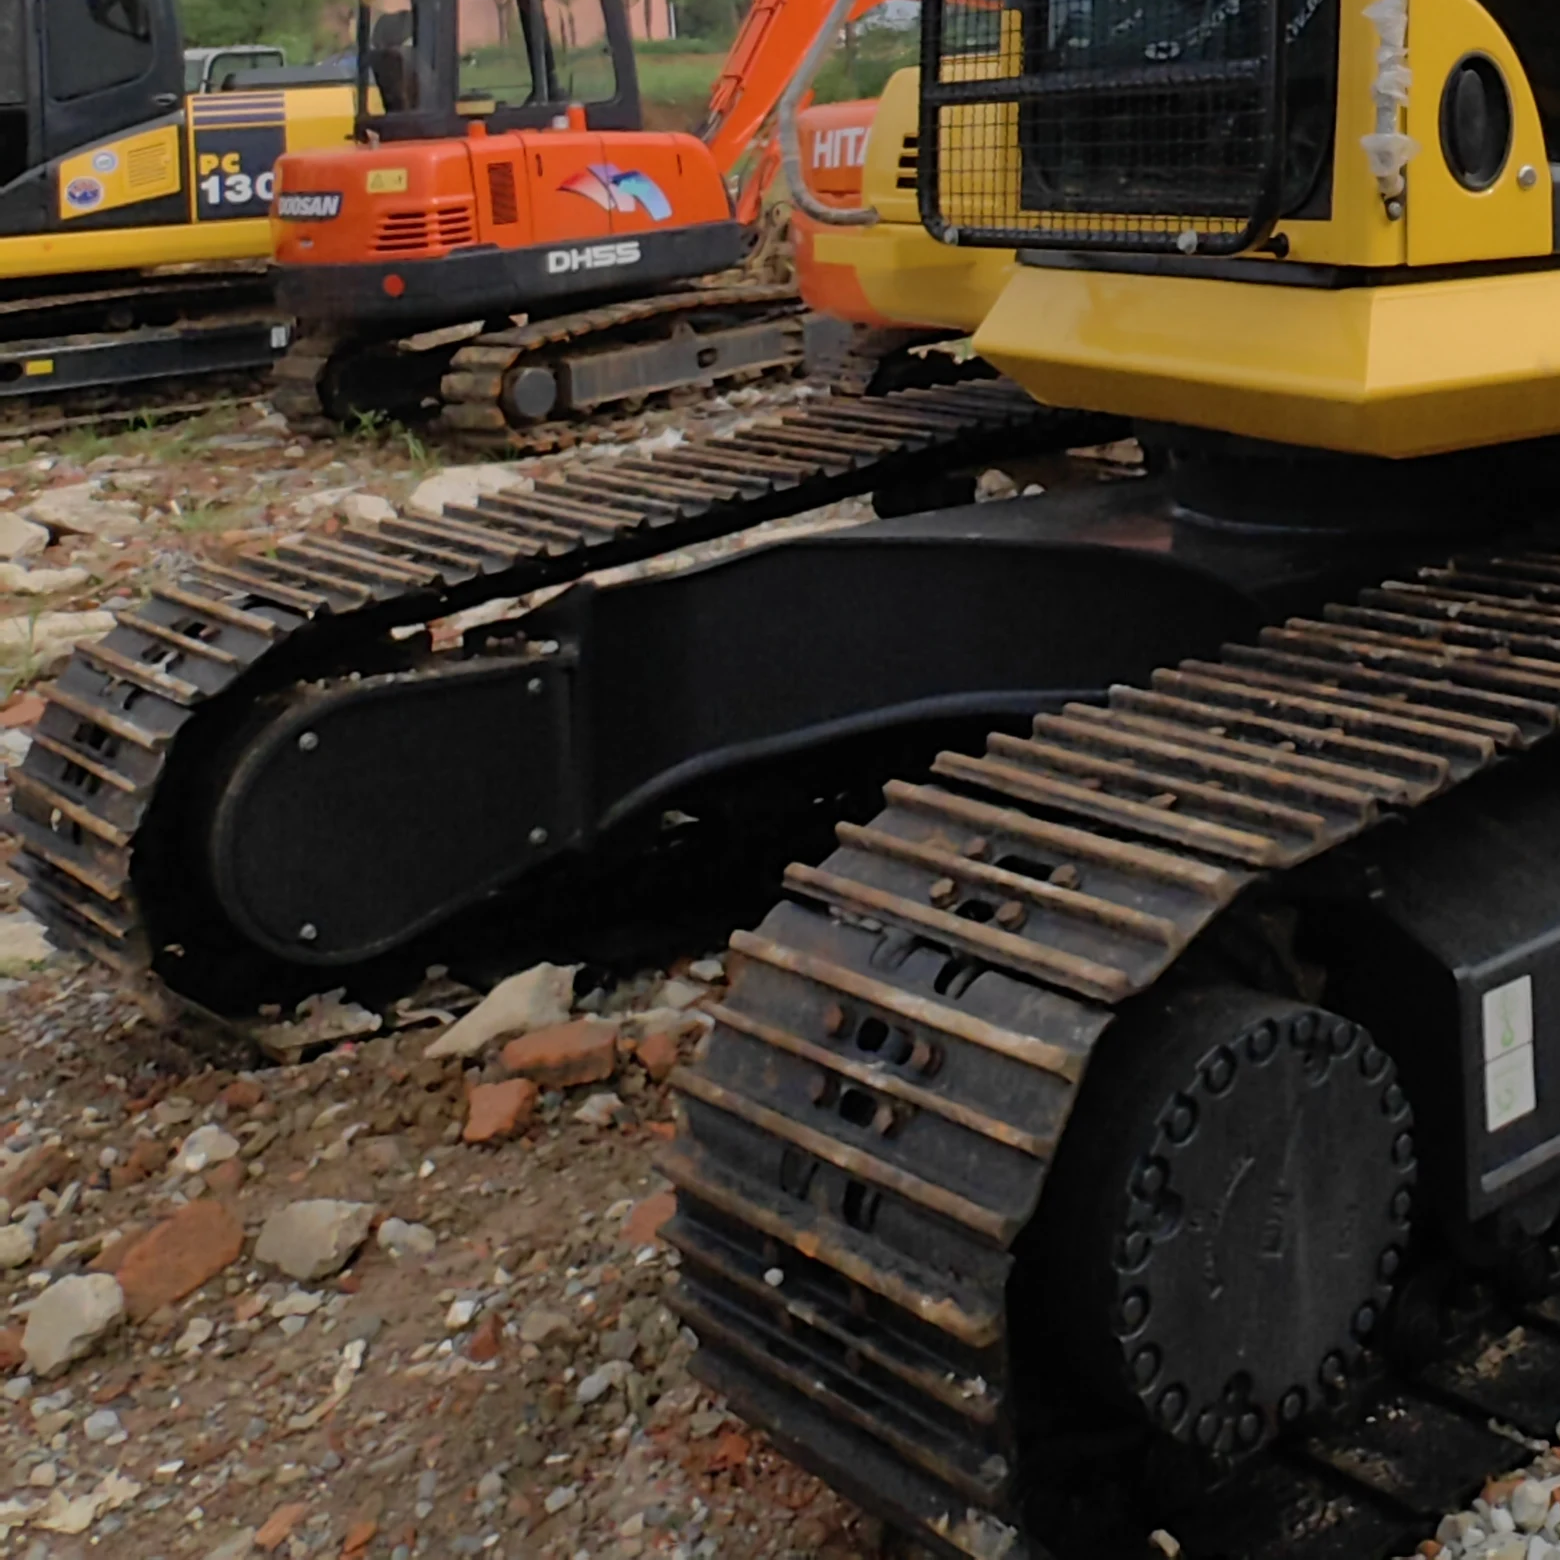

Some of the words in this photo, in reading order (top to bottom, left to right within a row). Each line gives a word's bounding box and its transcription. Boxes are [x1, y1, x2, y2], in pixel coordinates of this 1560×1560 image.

[199, 152, 240, 175] PC
[200, 172, 274, 205] 130
[547, 241, 642, 274] DH55
